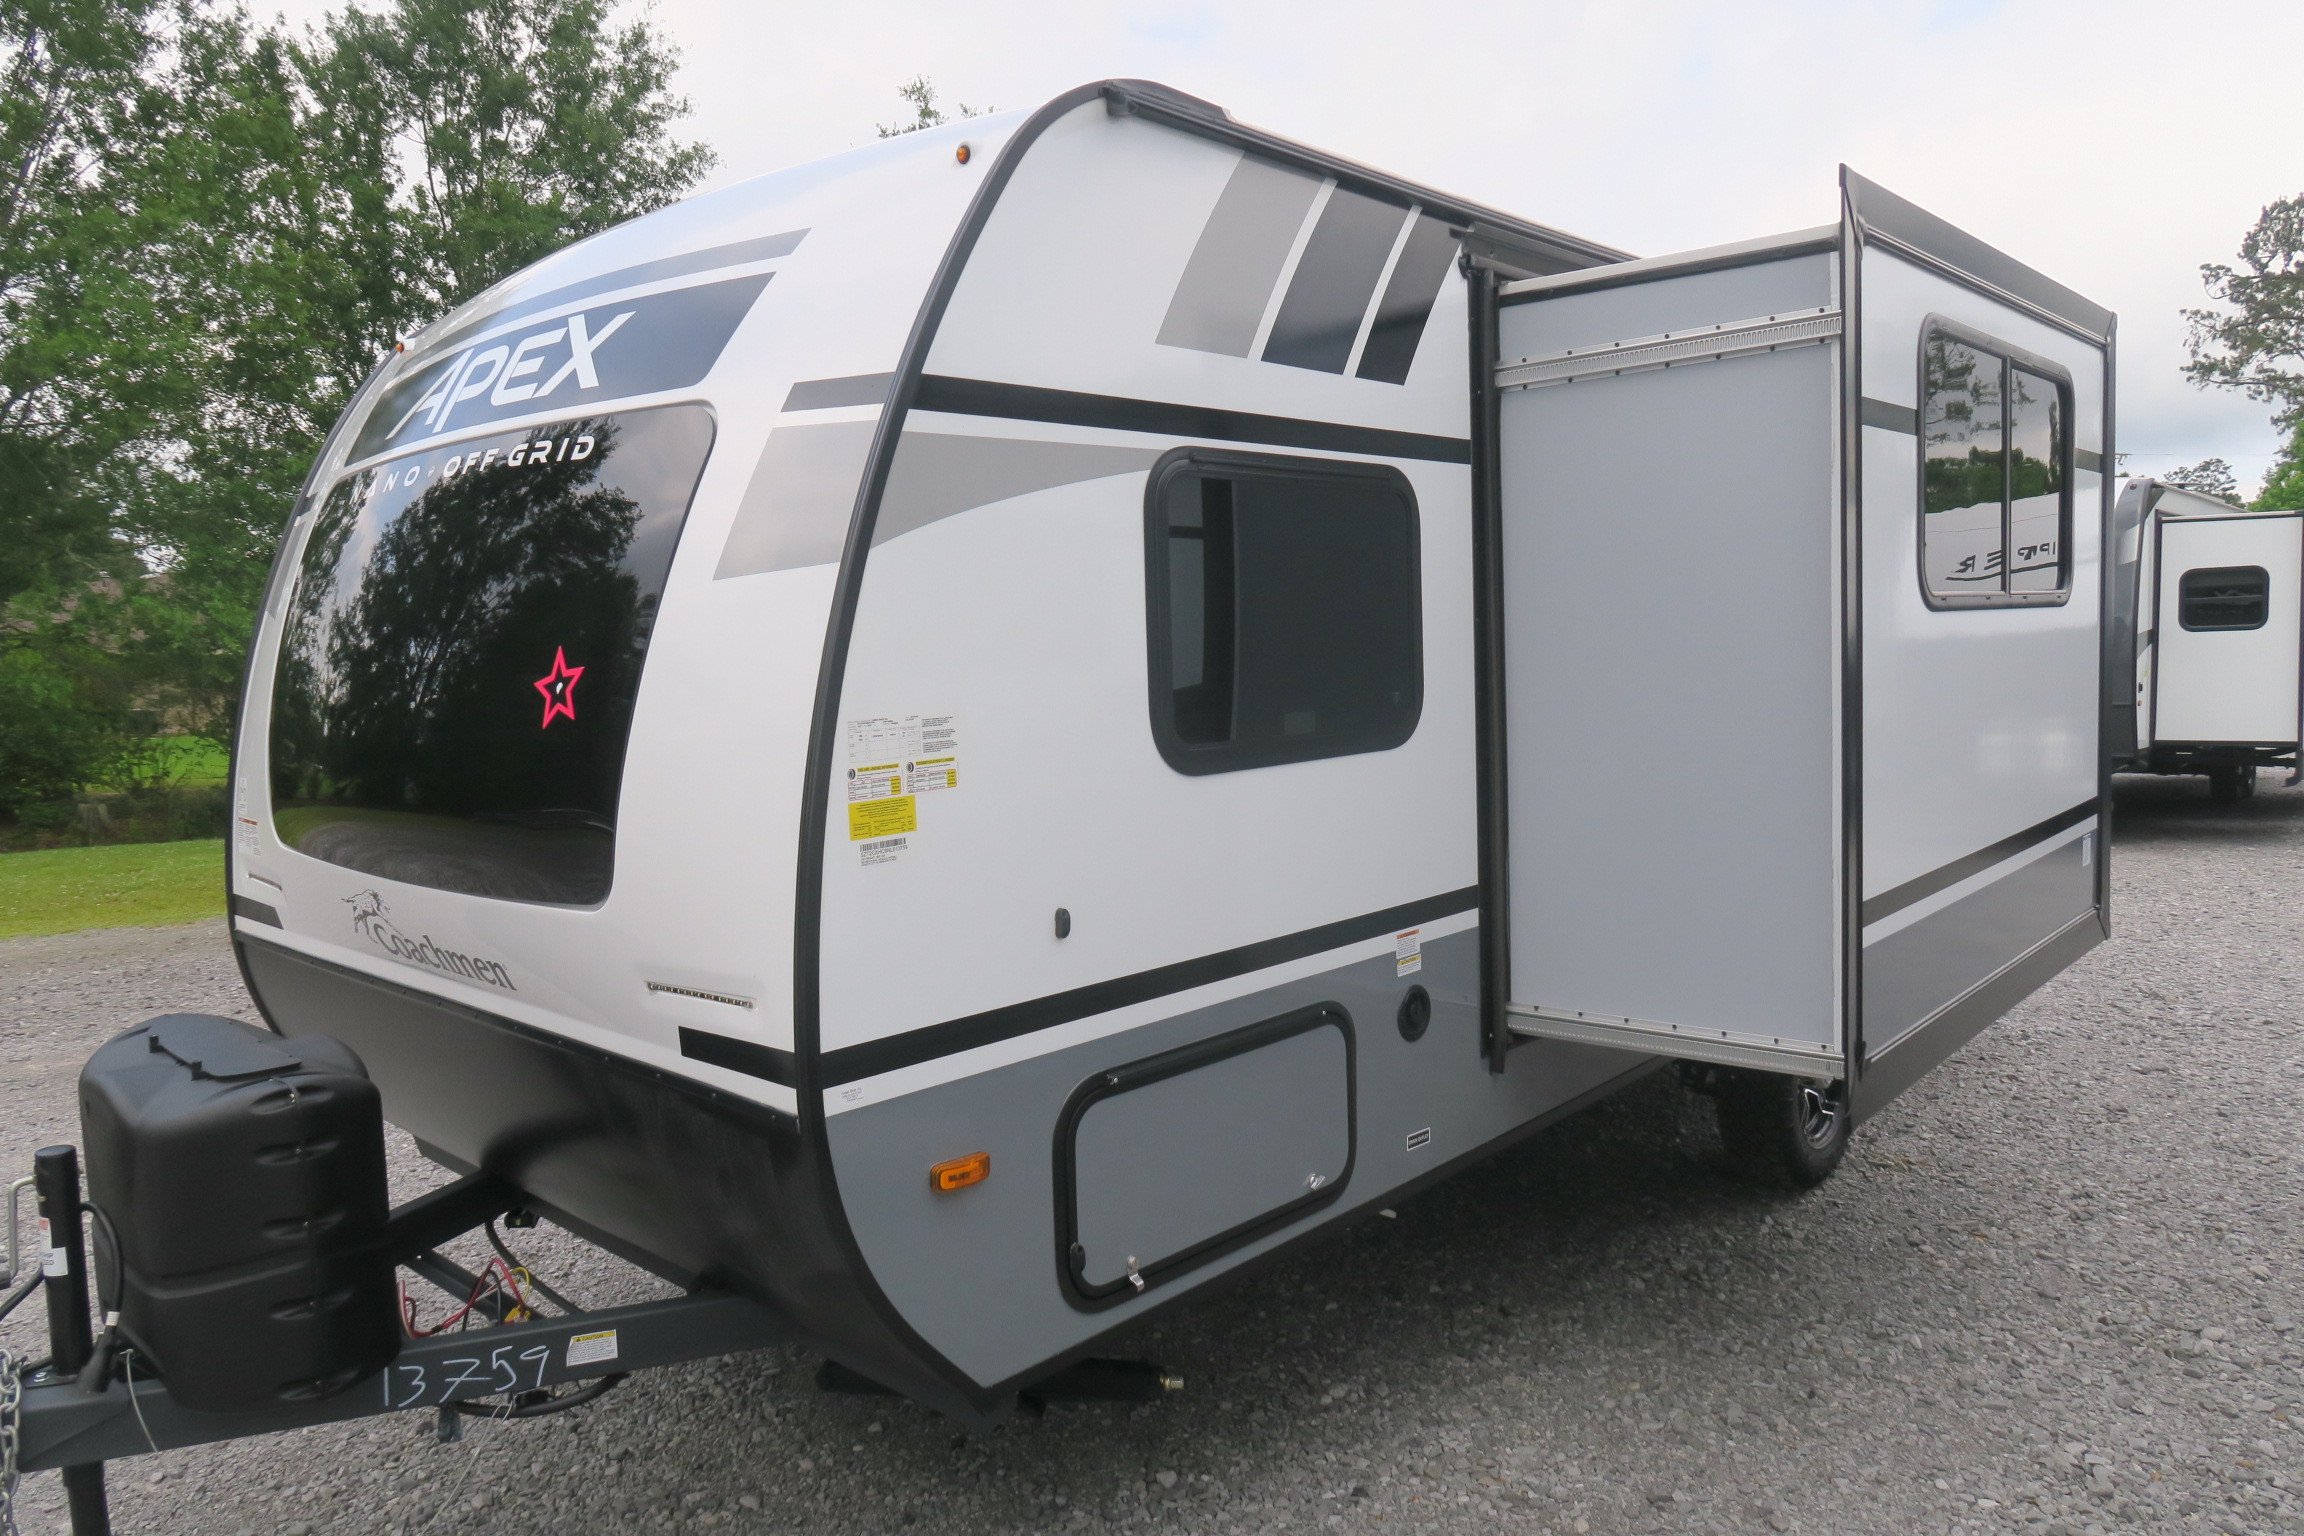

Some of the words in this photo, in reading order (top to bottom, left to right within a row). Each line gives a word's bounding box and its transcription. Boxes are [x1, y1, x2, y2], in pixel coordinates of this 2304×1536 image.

[385, 310, 637, 440] APEX
[349, 465, 421, 505] NANO
[443, 448, 500, 478] OFF
[507, 435, 595, 467] GRID
[373, 922, 517, 991] Coachmen
